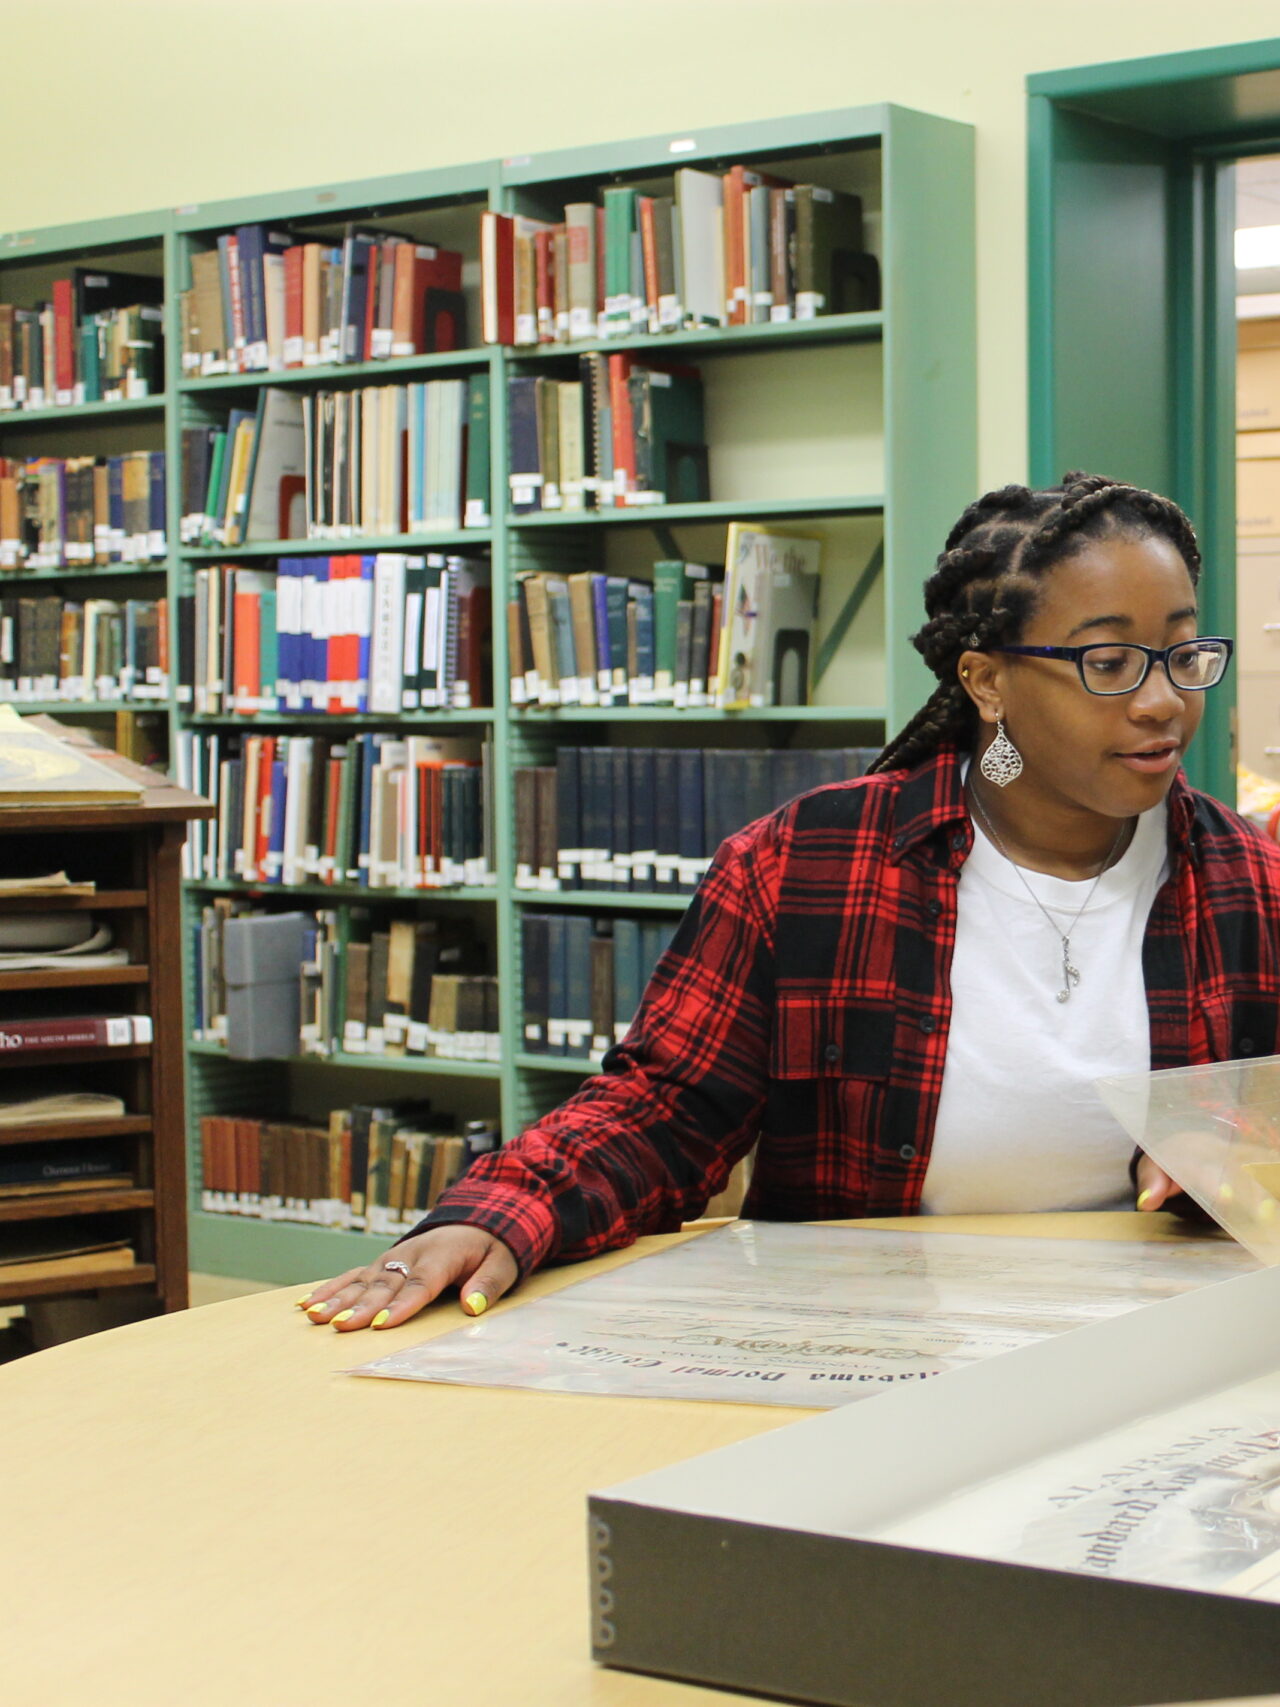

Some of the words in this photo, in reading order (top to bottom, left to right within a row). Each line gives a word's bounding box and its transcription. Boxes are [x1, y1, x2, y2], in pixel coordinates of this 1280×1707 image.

[782, 545, 806, 574] the
[668, 1365, 787, 1382] Normal
[1047, 1426, 1243, 1508] ALABAMA
